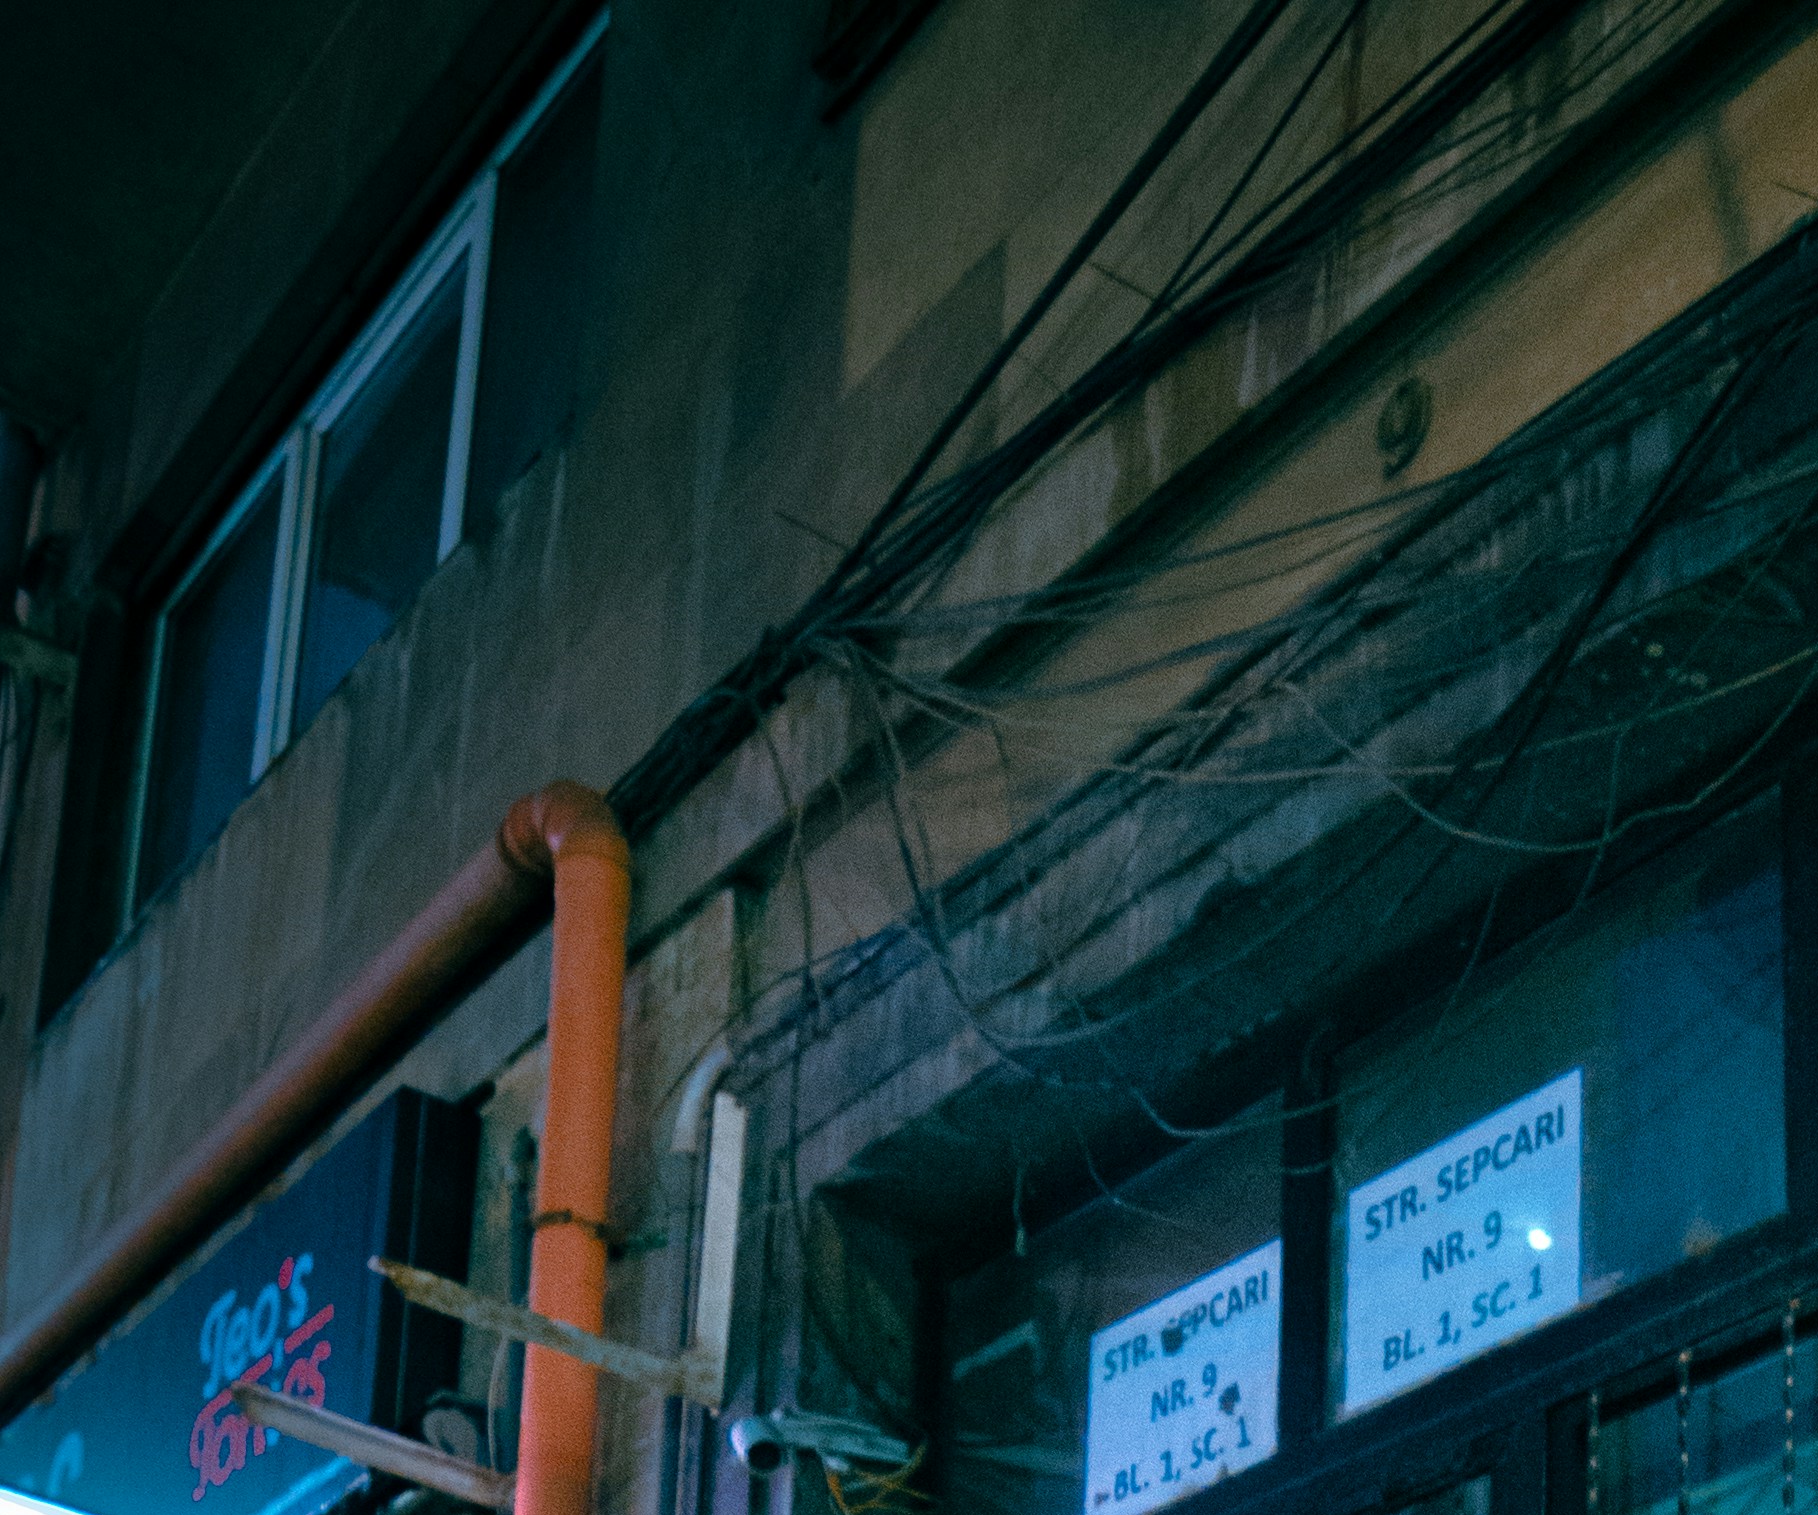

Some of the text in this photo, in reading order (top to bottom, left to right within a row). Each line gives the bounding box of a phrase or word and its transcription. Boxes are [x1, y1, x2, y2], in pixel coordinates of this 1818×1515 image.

[1364, 1107, 1564, 1241] STR. SEPCARI
[1421, 1211, 1501, 1282] NR. 9
[1103, 1270, 1268, 1382] STR. EPCARI
[1383, 1265, 1543, 1372] BL. 1, SC. 1
[1151, 1361, 1218, 1422] NR. 9
[1114, 1416, 1252, 1501] BL. 1, SC. 1
